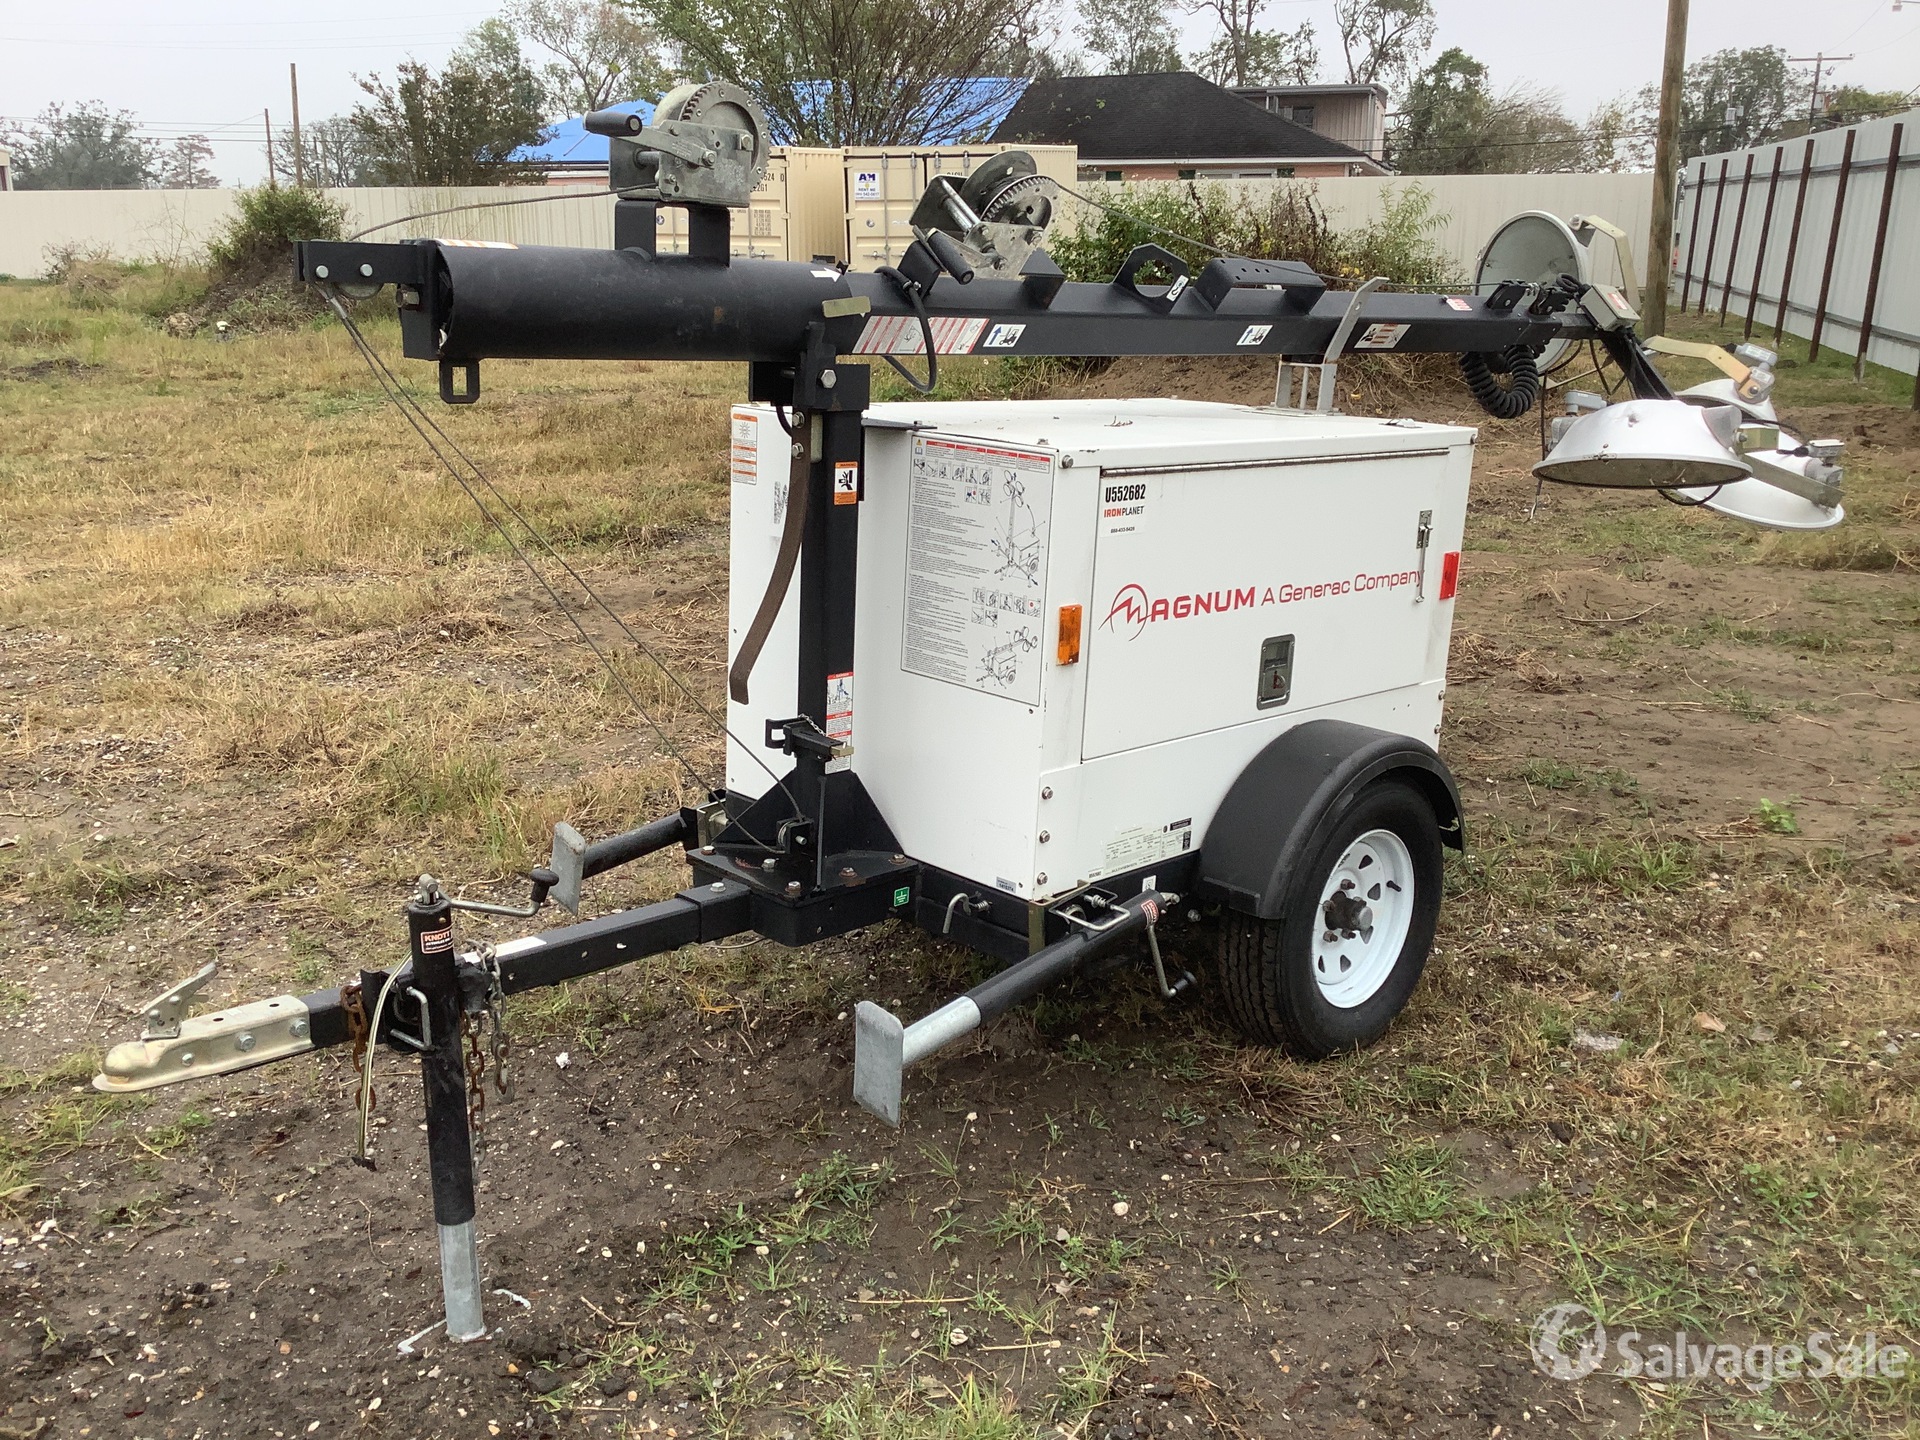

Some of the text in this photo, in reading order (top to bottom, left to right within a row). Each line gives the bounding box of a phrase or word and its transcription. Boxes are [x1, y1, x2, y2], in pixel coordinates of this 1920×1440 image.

[1105, 484, 1146, 503] U552682
[1261, 587, 1275, 607] A
[1279, 579, 1351, 605] Generac
[1355, 569, 1425, 593] Company
[424, 930, 450, 942] KNOTT
